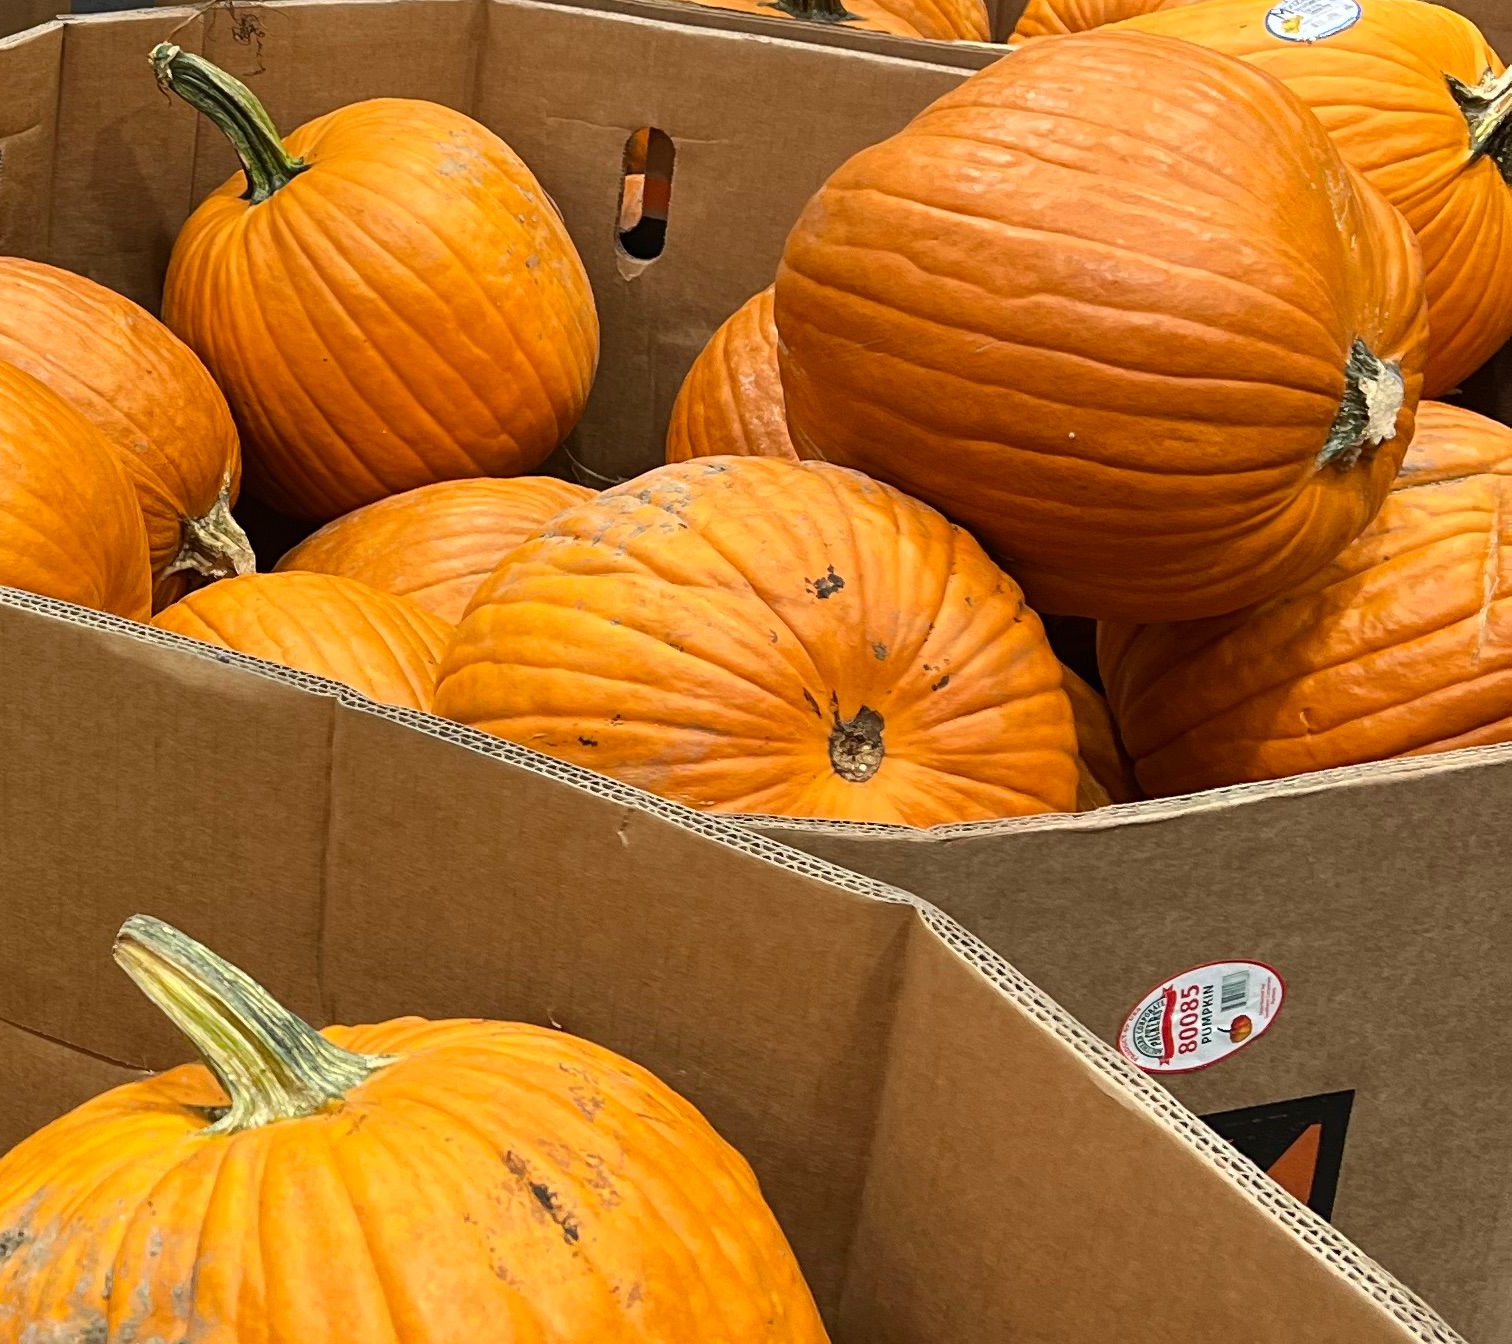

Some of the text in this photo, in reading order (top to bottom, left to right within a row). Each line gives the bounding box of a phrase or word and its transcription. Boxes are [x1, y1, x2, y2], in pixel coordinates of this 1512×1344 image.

[1135, 999, 1165, 1033] CORPORATE
[1144, 1008, 1164, 1046] PACKERS
[1178, 983, 1200, 1054] 80085
[1200, 984, 1214, 1044] PUMPKIN
